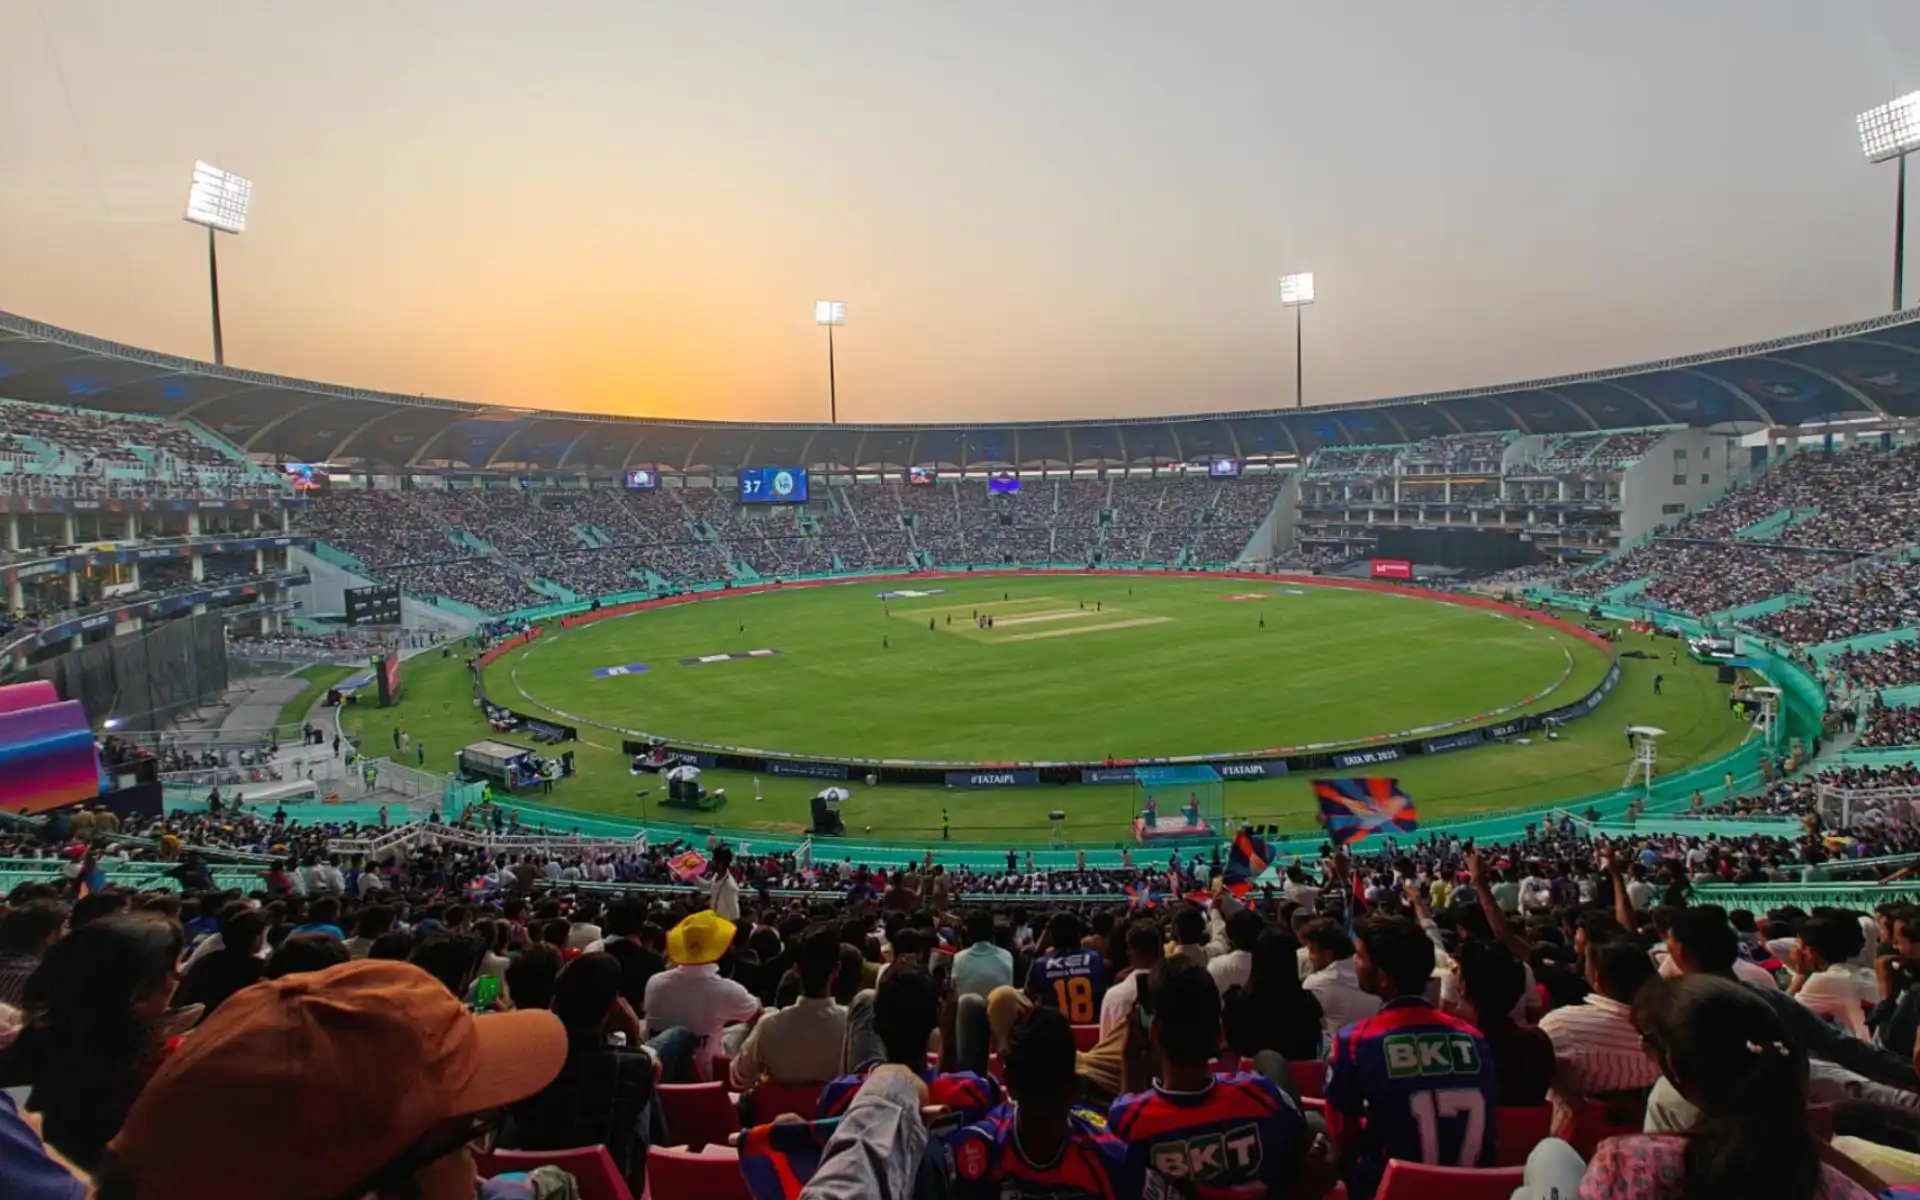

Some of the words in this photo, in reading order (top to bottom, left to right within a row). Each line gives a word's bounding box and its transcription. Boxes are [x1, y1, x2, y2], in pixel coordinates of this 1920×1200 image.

[743, 480, 760, 494] 37
[1046, 953, 1091, 970] KEI
[1053, 976, 1094, 1022] 18
[1386, 1039, 1476, 1069] BKT
[1409, 1088, 1486, 1168] 17
[1156, 1135, 1256, 1178] BKT
